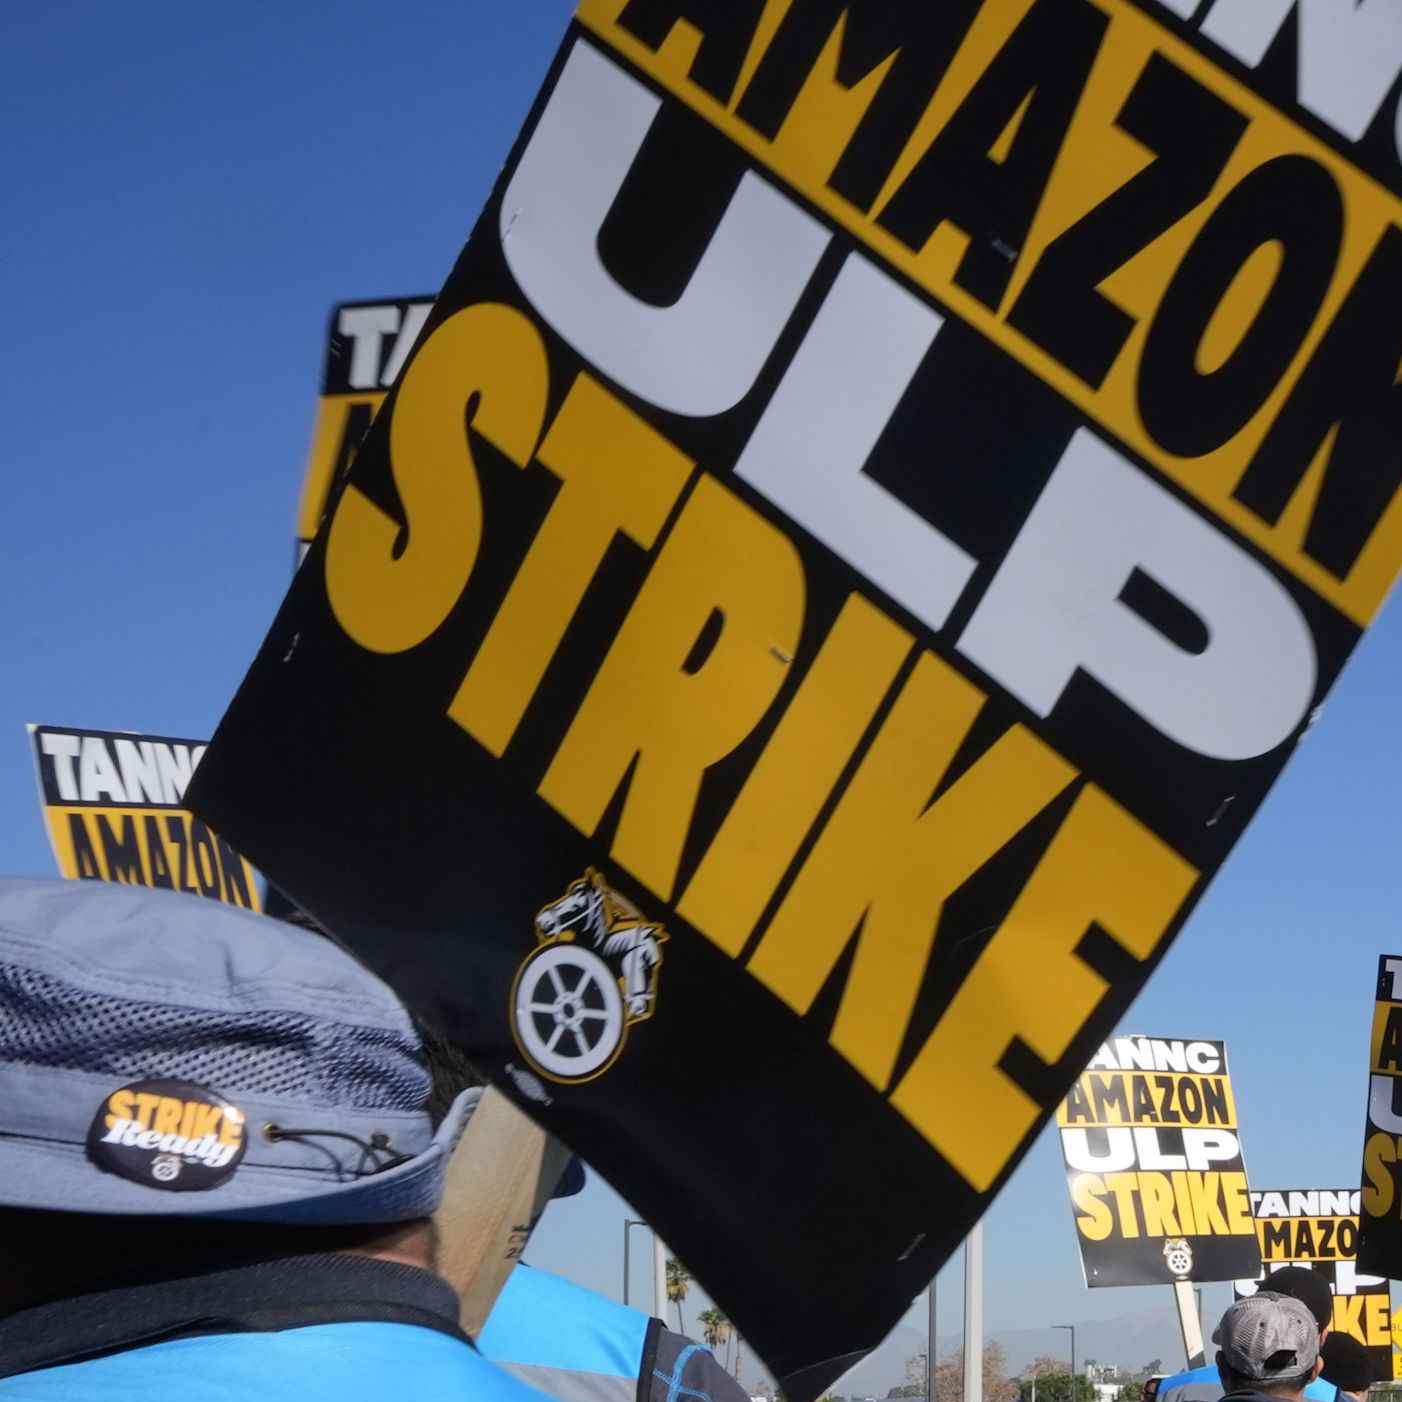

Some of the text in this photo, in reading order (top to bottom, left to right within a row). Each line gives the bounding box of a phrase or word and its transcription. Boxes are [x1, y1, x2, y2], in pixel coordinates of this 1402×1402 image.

[499, 36, 1318, 761] ULP
[40, 733, 208, 804] TANN
[325, 302, 1201, 1193] STRIKE
[1088, 1038, 1220, 1074] ANNC
[105, 1089, 246, 1147] STRIKE
[1067, 1073, 1230, 1125] AMAZON
[100, 1118, 240, 1168] Ready
[1061, 1127, 1240, 1172] ULP
[1072, 1171, 1256, 1241] STRIKE
